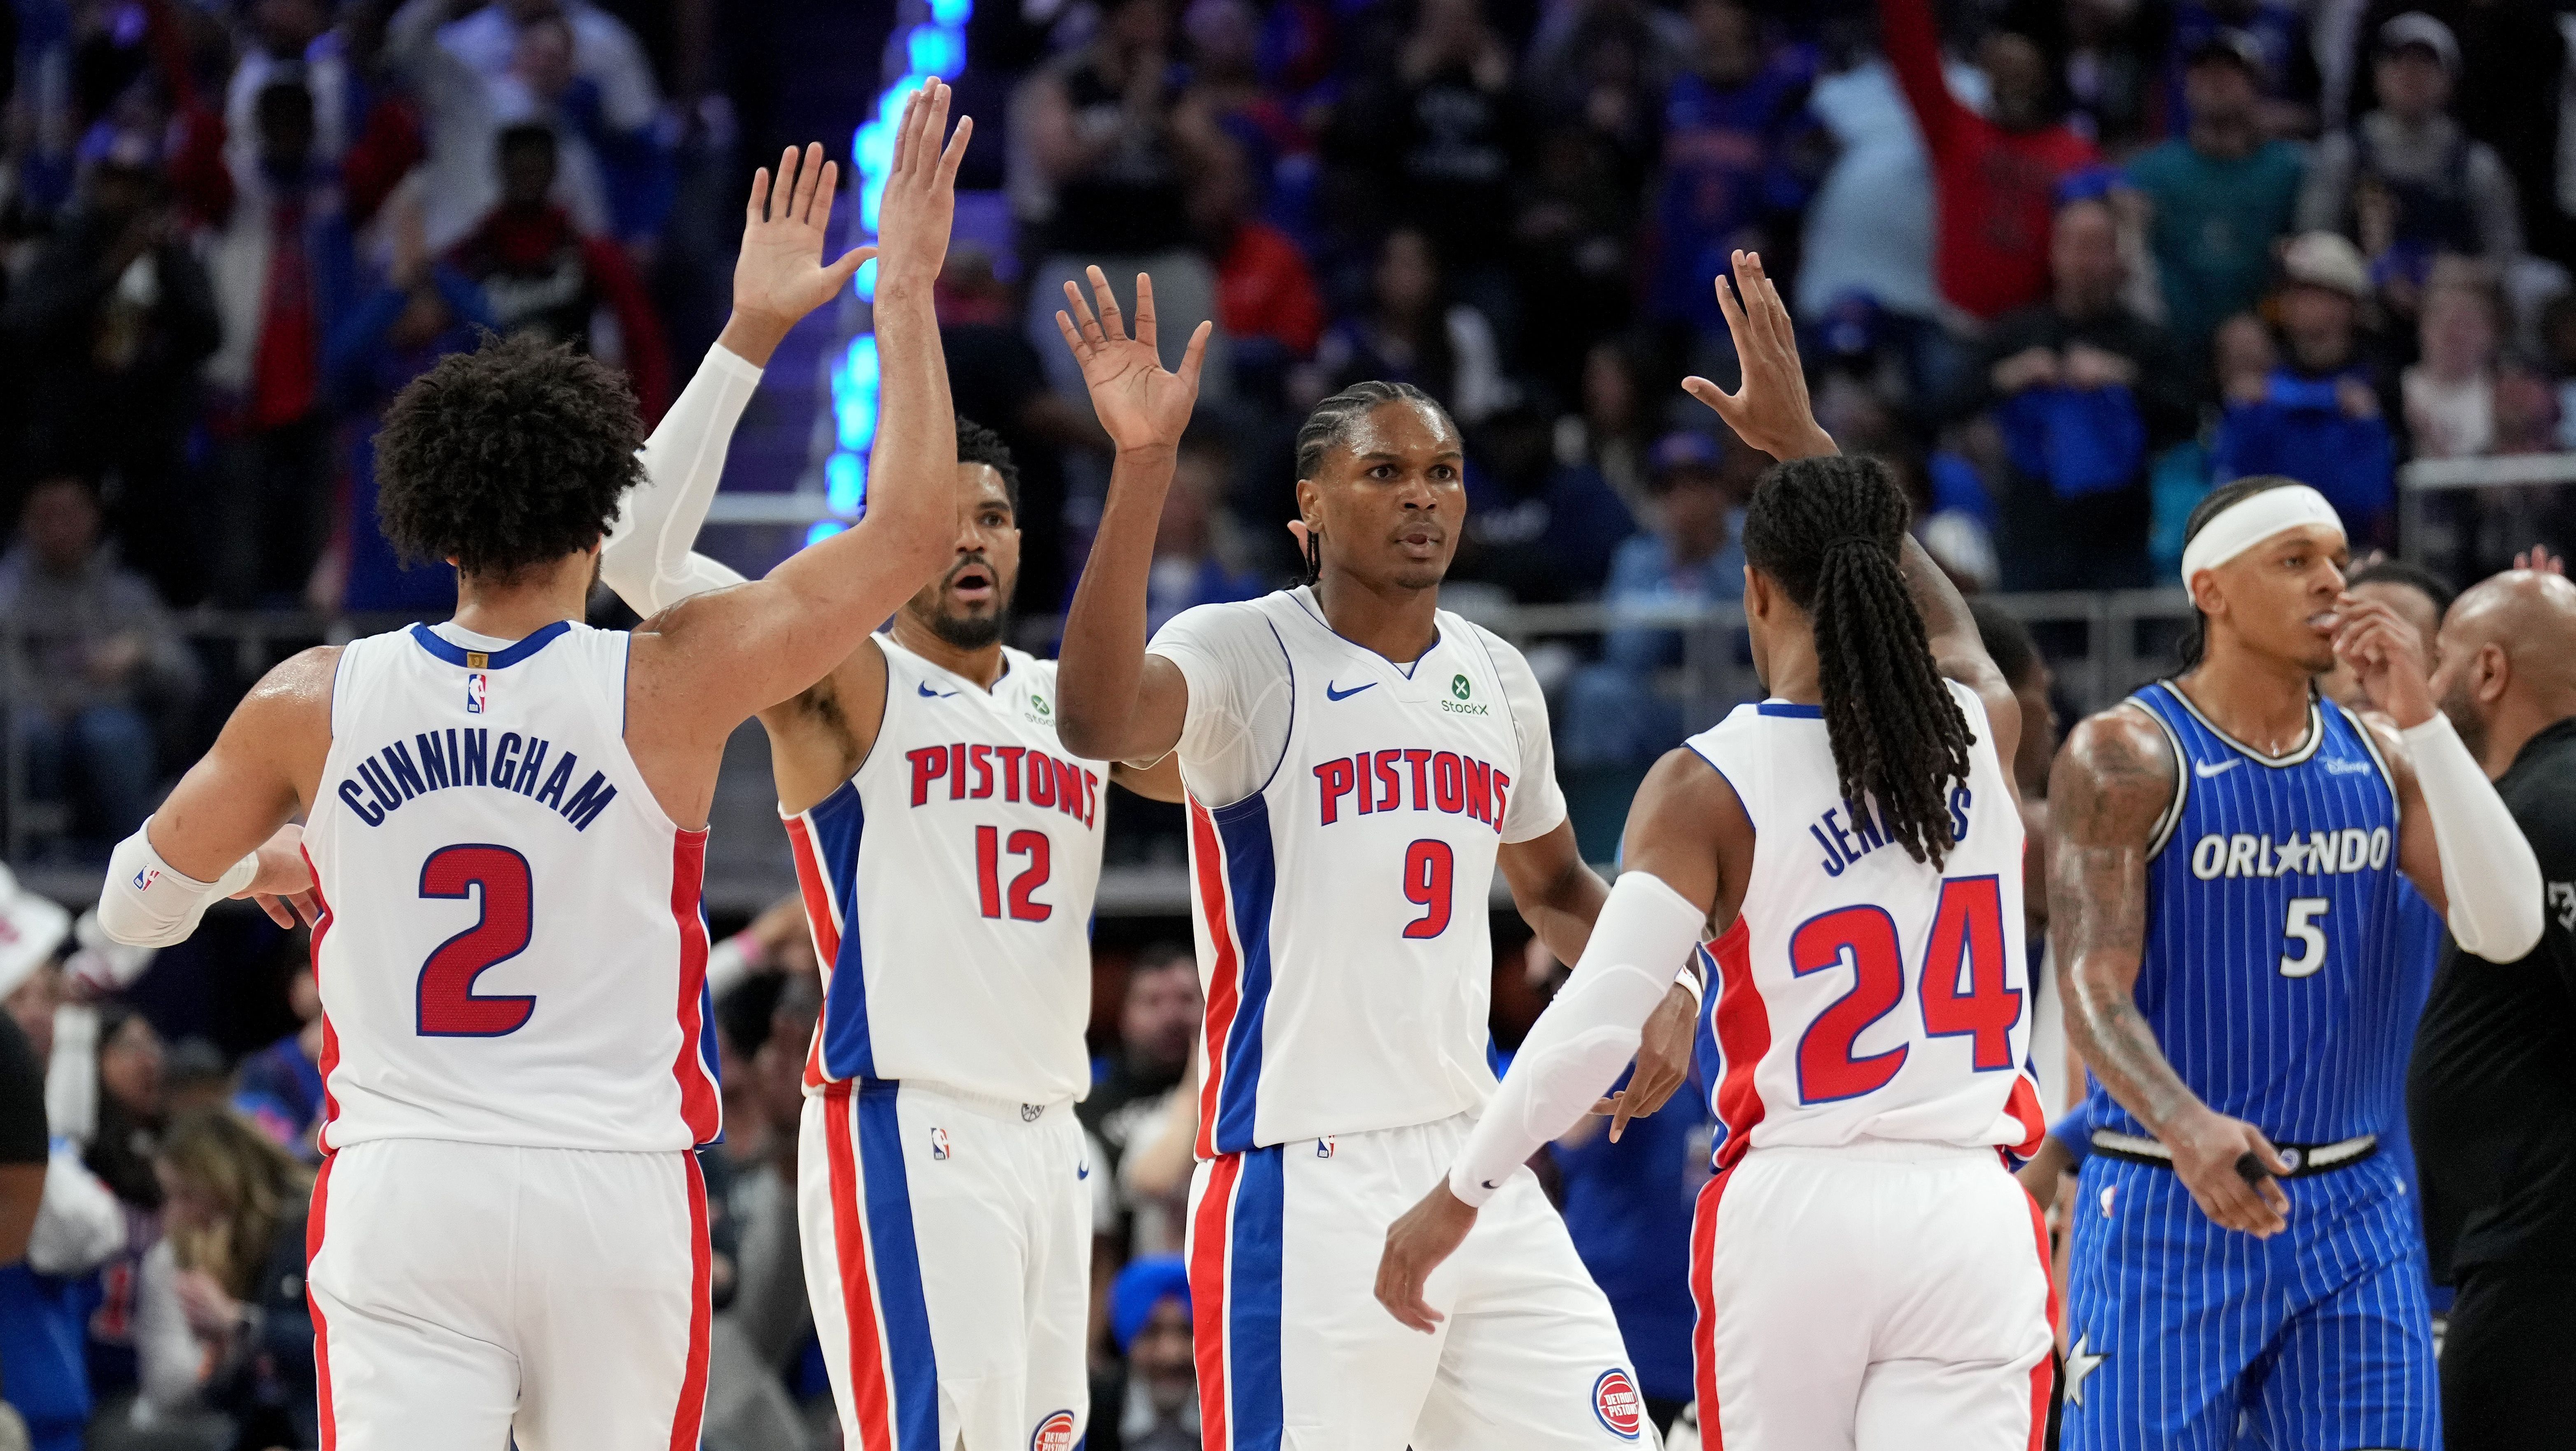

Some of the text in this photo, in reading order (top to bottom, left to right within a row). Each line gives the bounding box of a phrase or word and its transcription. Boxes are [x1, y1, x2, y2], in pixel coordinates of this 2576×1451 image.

[1024, 713, 1056, 727] Stoc
[1441, 700, 1488, 716] StockX
[338, 728, 618, 832] CUNNINGHAM
[905, 743, 1098, 831] PISTONS
[1312, 748, 1510, 834] PISTONS
[974, 824, 1052, 923] 12
[1809, 787, 1972, 877] JENS
[1402, 838, 1454, 939] 9
[416, 843, 537, 1038] 2
[2279, 897, 2330, 978] 5
[1788, 873, 2023, 1106] 24
[1604, 1392, 1635, 1405] DETROIT
[1607, 1404, 1638, 1417] PISTONS
